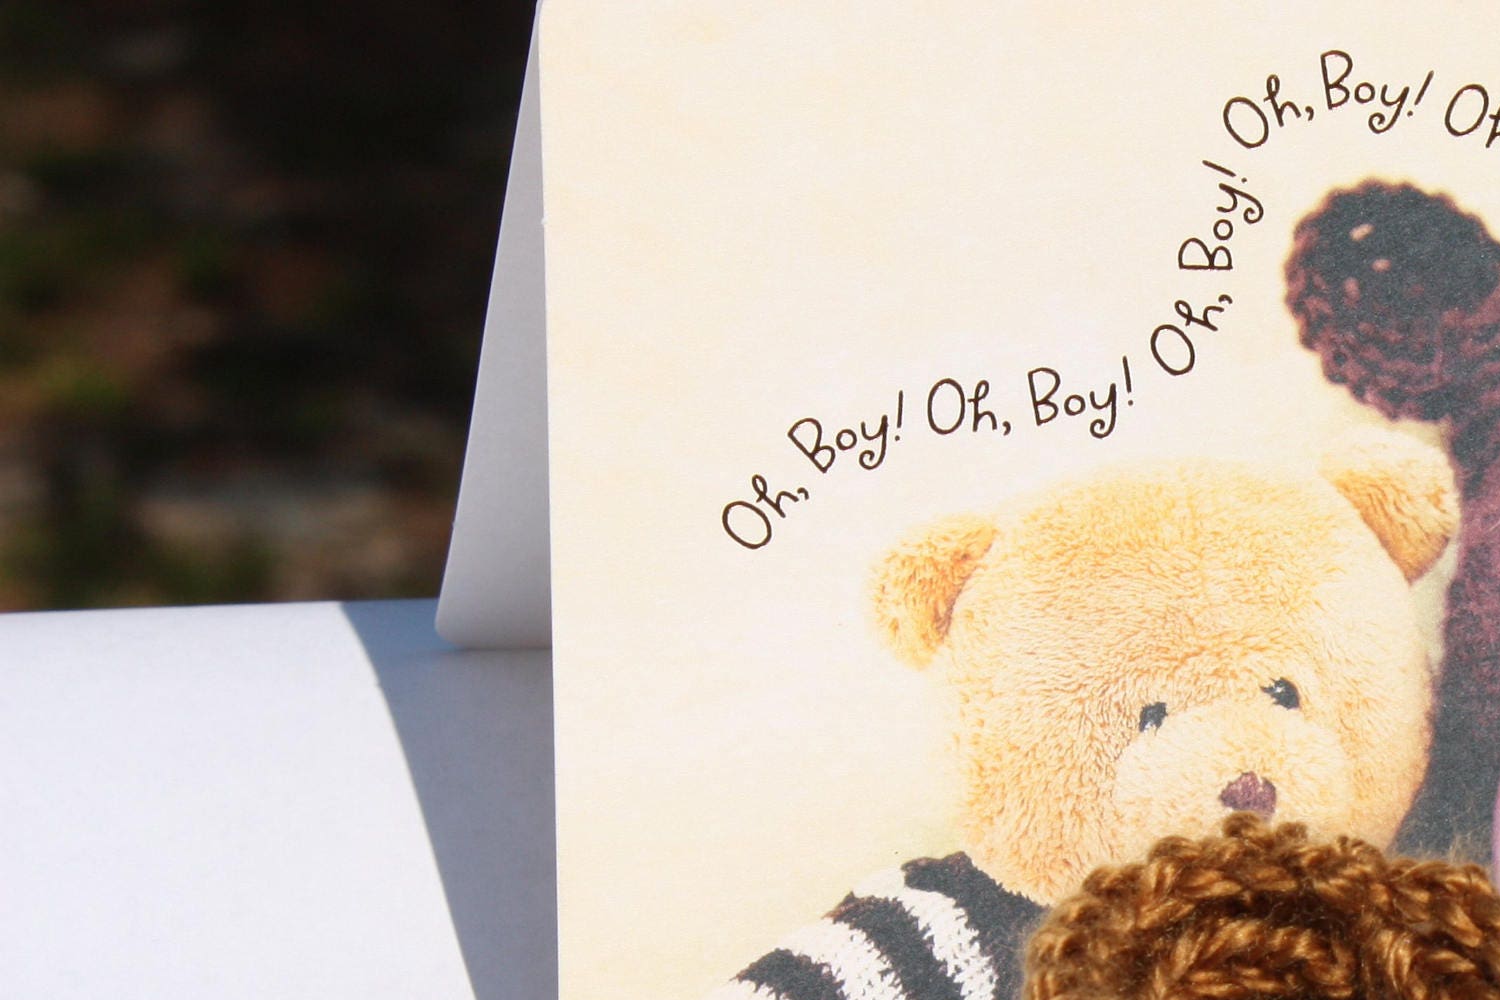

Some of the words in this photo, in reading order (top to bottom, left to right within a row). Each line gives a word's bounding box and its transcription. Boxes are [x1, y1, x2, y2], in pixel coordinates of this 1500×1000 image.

[1223, 75, 1315, 149] Oh,
[1320, 50, 1434, 133] Boy!
[1177, 160, 1264, 271] Boy!
[1150, 294, 1233, 376] Oh,
[787, 390, 904, 474] Boy!
[927, 378, 1011, 435] Oh,
[1028, 356, 1133, 439] Boy!
[723, 474, 809, 550] Oh,
